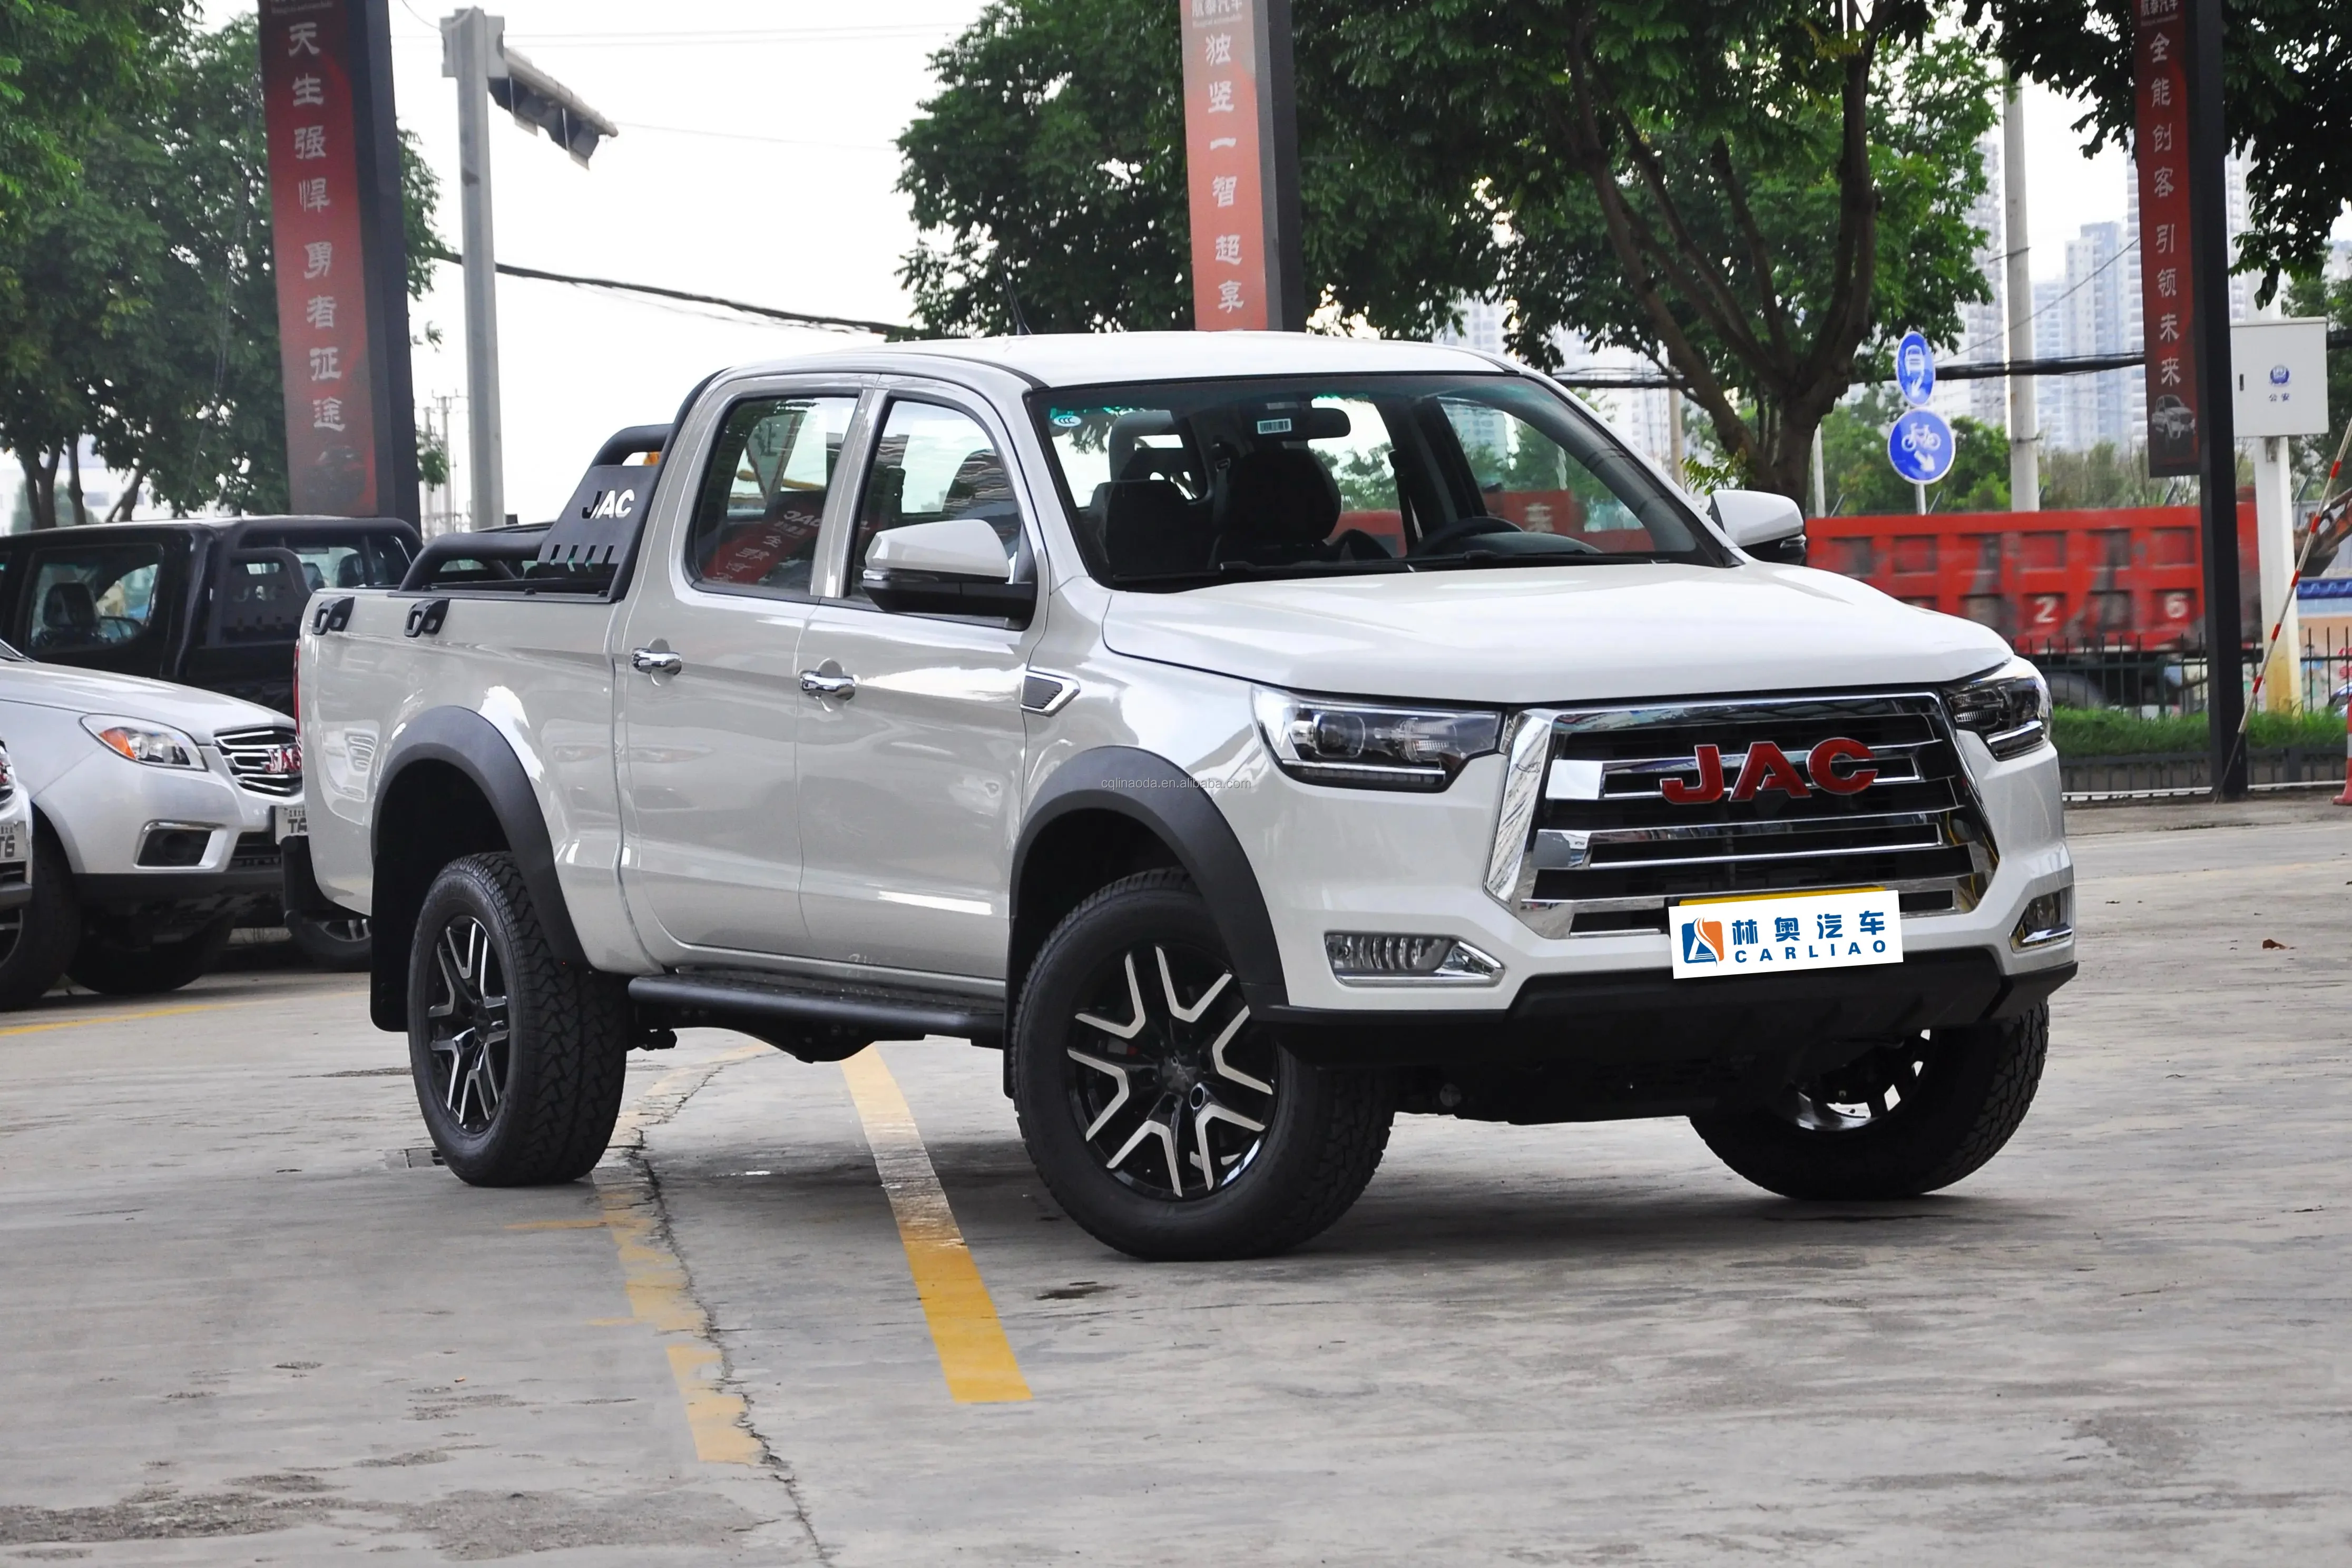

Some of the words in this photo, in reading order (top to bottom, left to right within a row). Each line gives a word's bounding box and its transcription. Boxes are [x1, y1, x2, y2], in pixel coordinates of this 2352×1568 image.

[2269, 393, 2290, 402] 公安
[582, 488, 635, 520] JAC
[1659, 737, 1879, 805] JAC
